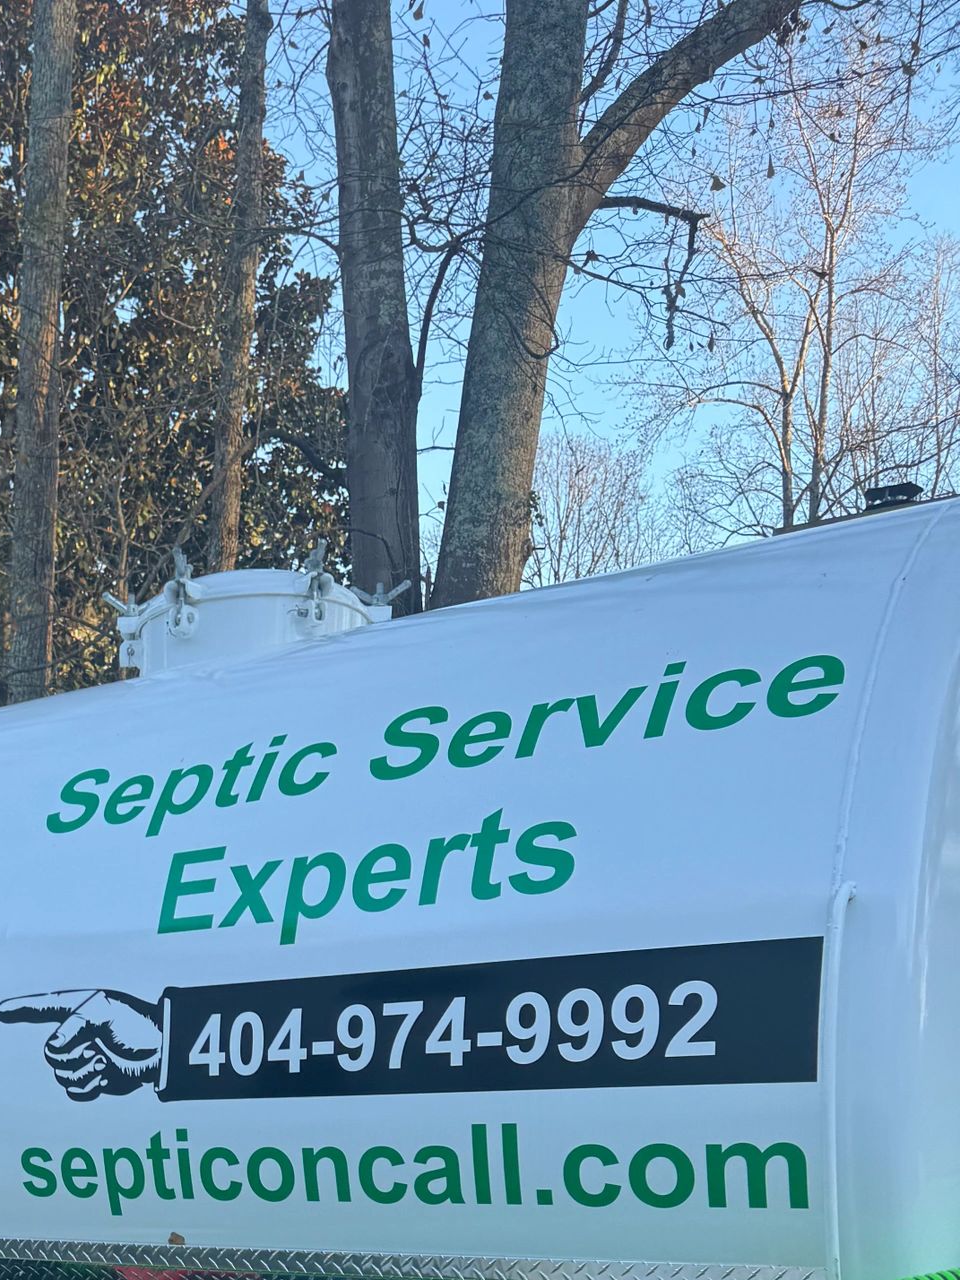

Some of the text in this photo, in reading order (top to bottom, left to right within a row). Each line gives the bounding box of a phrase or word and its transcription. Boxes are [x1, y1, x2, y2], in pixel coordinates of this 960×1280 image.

[46, 654, 846, 838] Septic Service
[157, 807, 577, 946] Experts
[189, 980, 718, 1078] 404-974-9992
[20, 1122, 810, 1217] septiconcall.com
